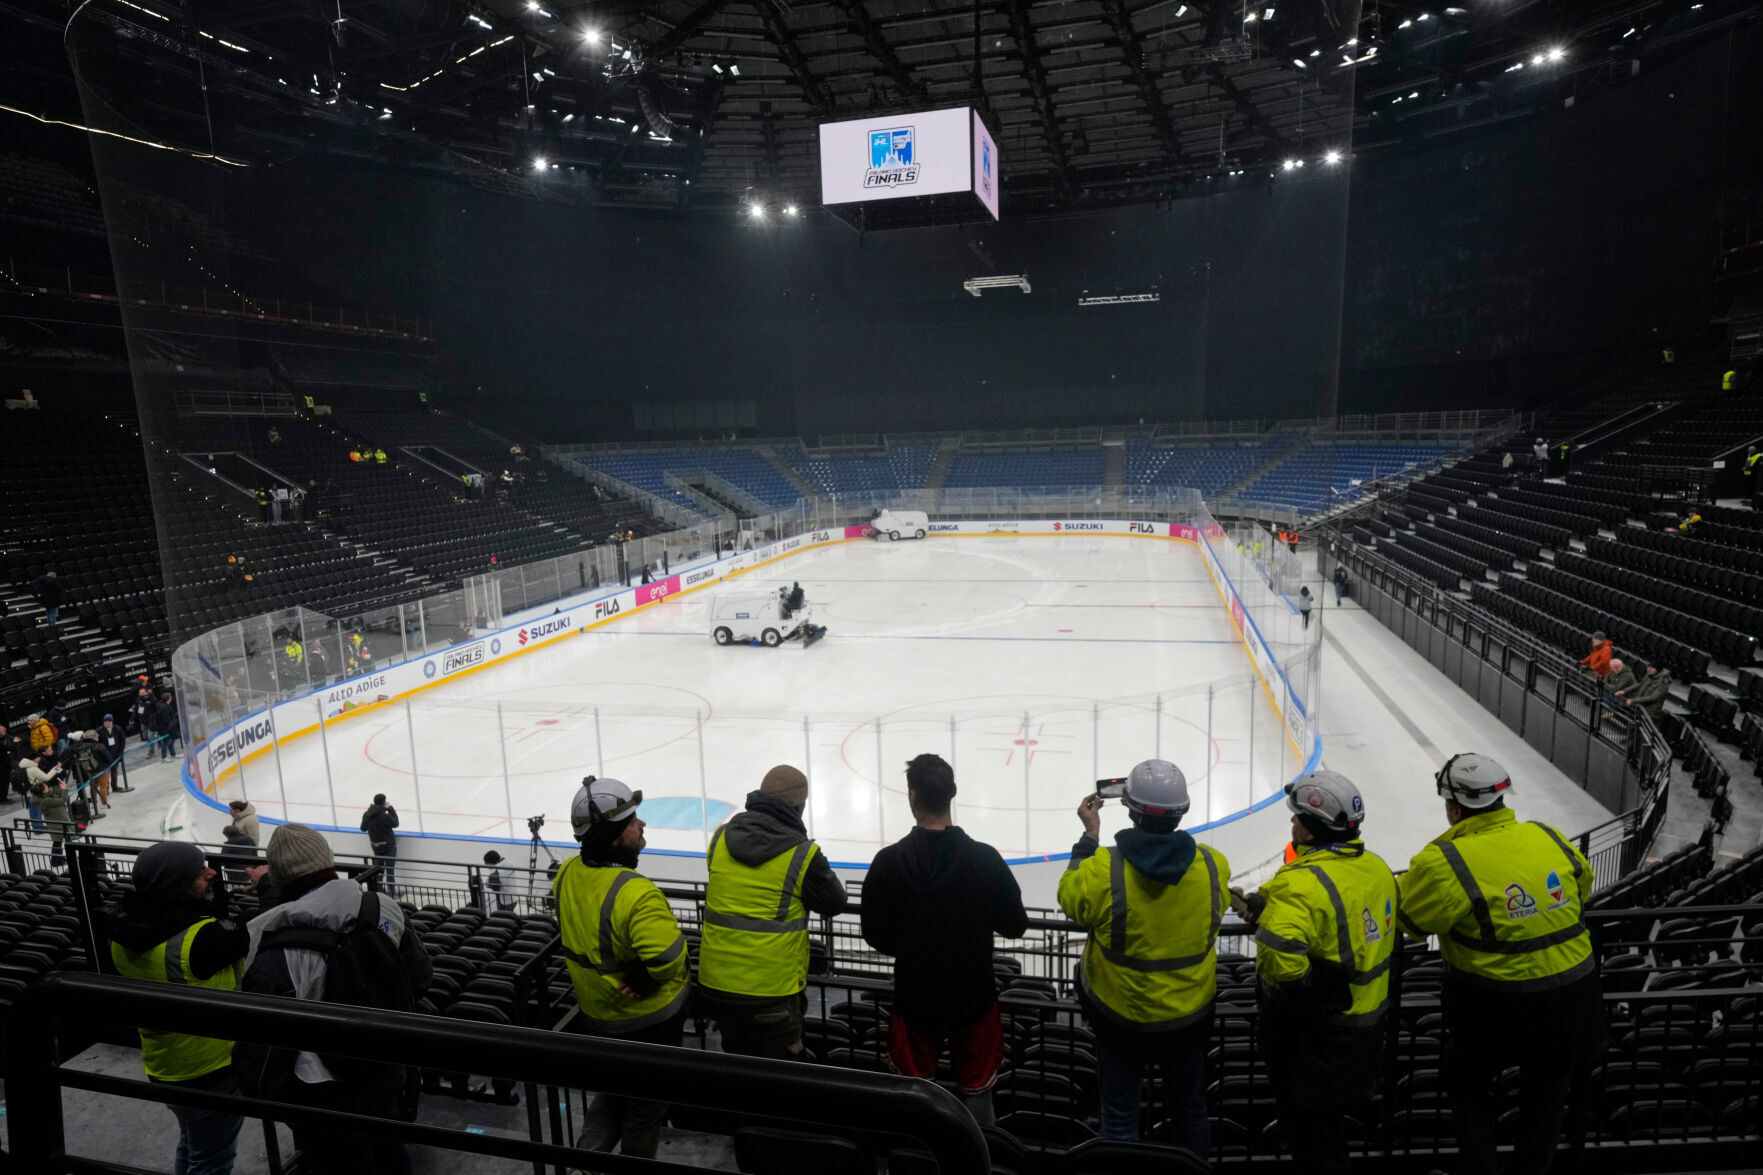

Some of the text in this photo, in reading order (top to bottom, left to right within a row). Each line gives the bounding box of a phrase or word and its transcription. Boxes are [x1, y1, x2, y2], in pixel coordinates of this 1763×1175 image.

[867, 171, 916, 185] FINALS
[1130, 522, 1154, 533] FILA
[812, 531, 830, 542] FILA
[686, 568, 714, 584] ESSELUNGA
[650, 581, 668, 599] enel
[595, 598, 620, 620] FILA
[530, 616, 571, 639] SUZUKI
[446, 650, 482, 671] FINALS
[329, 687, 353, 703] ALTO
[1510, 907, 1539, 918] ETERIA
